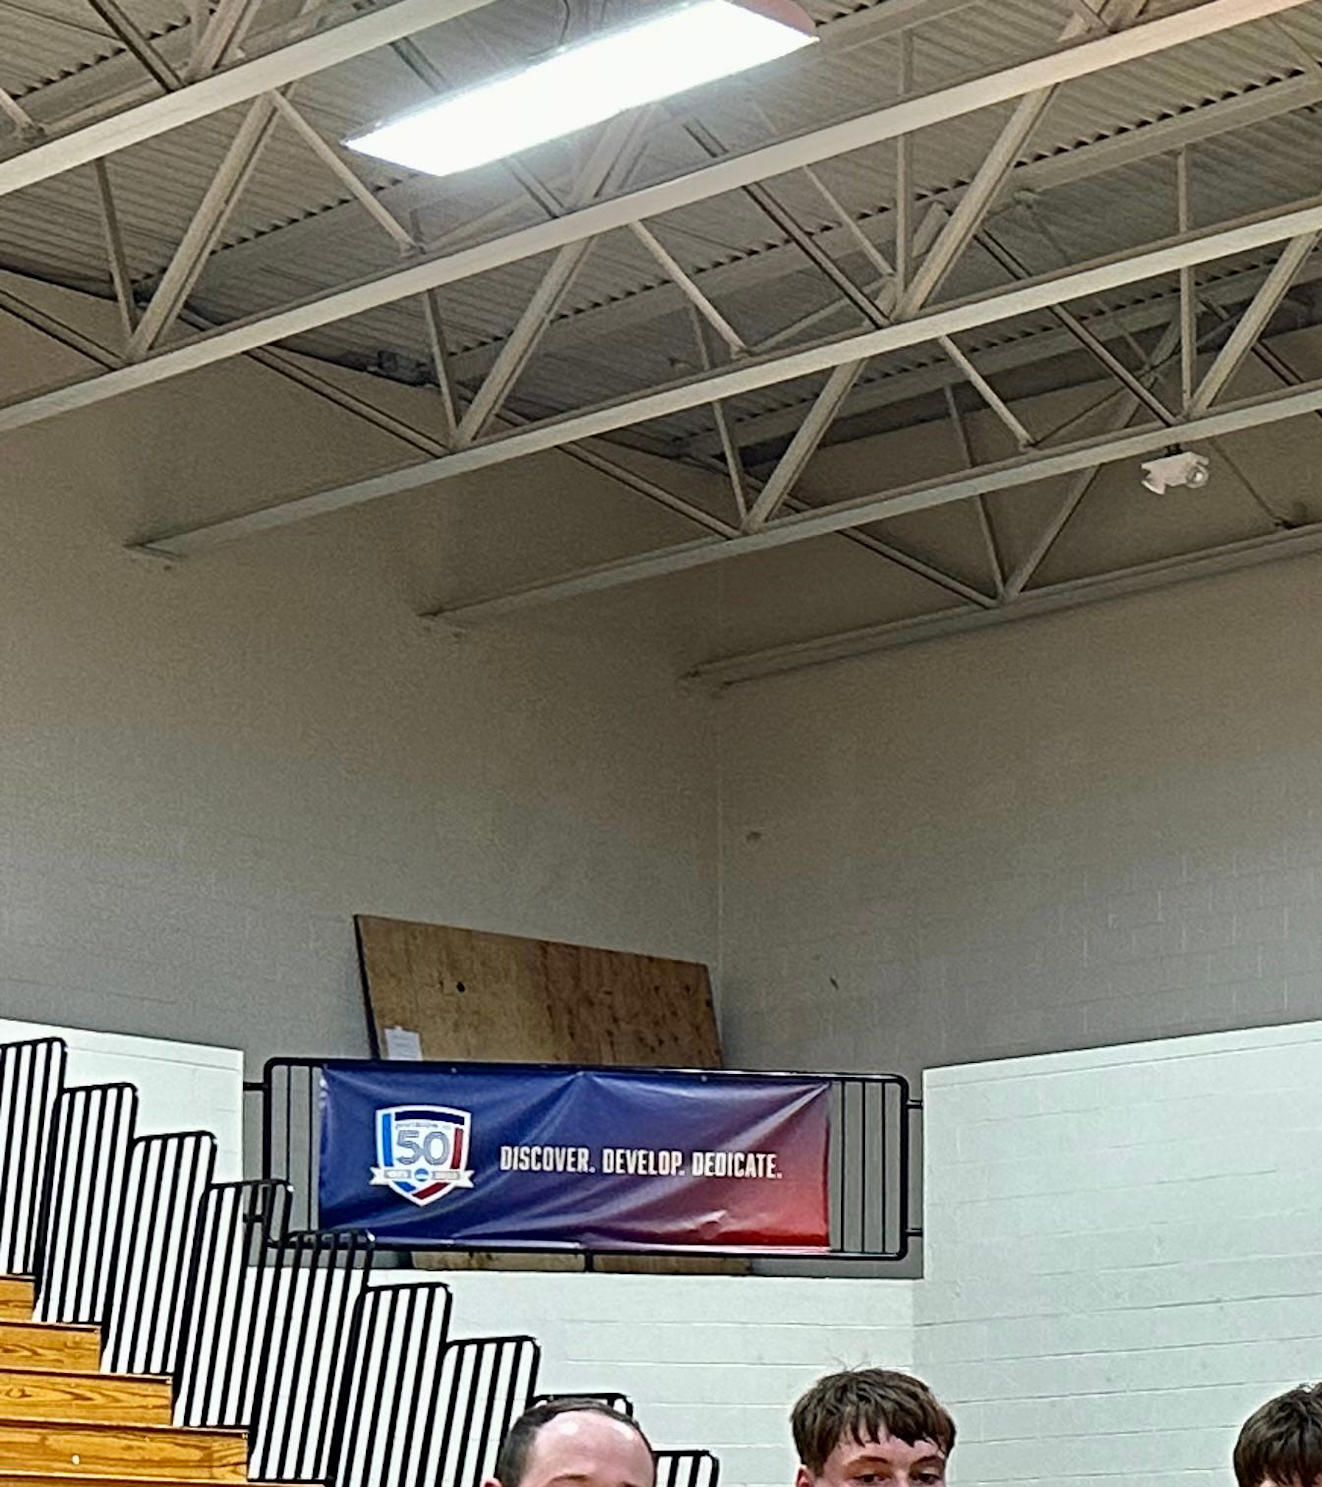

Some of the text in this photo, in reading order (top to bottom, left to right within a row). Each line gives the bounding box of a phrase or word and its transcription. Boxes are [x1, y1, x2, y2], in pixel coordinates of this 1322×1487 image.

[396, 1130, 450, 1165] 50
[500, 1146, 783, 1179] DISCOVER. DEVELOP. DEDICATE.
